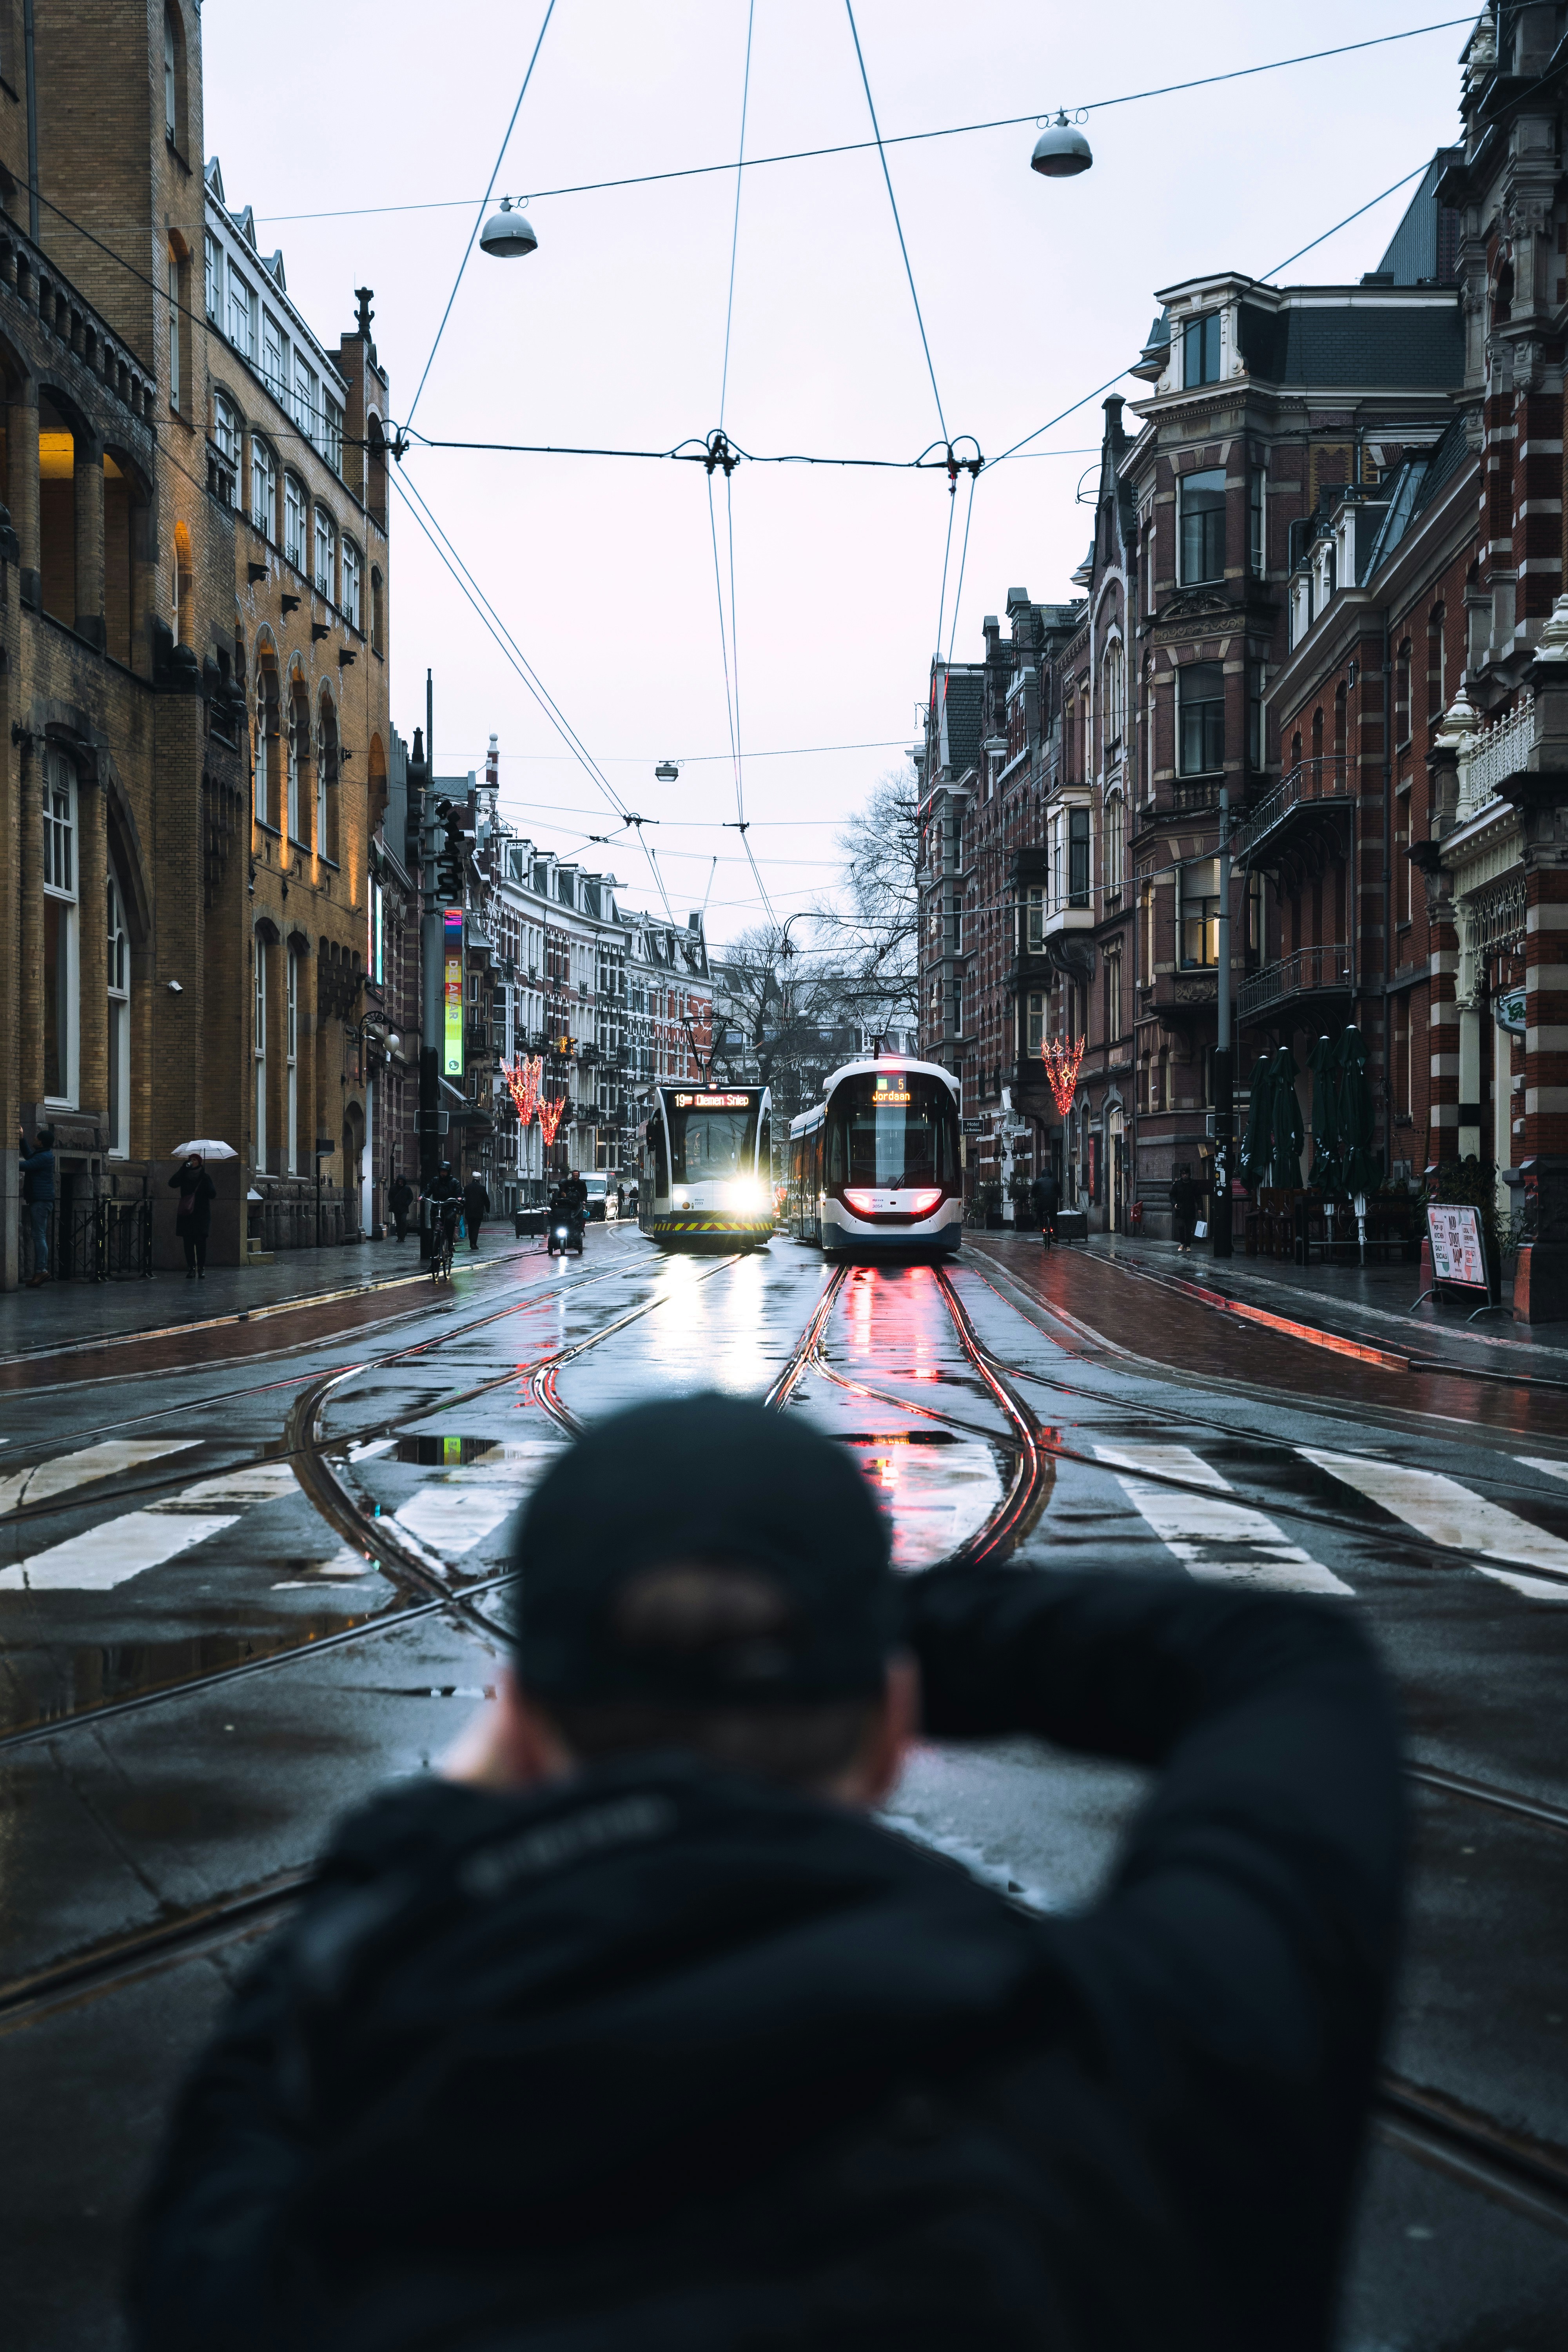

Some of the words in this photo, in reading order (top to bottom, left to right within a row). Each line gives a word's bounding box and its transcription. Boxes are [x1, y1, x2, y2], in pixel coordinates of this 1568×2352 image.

[448, 960, 458, 1020] DELAMAR
[898, 1078, 904, 1090] 5
[675, 1094, 685, 1107] 19
[697, 1094, 724, 1105] Diemen
[727, 1094, 749, 1106] Sniep
[873, 1091, 910, 1100] Jordaan
